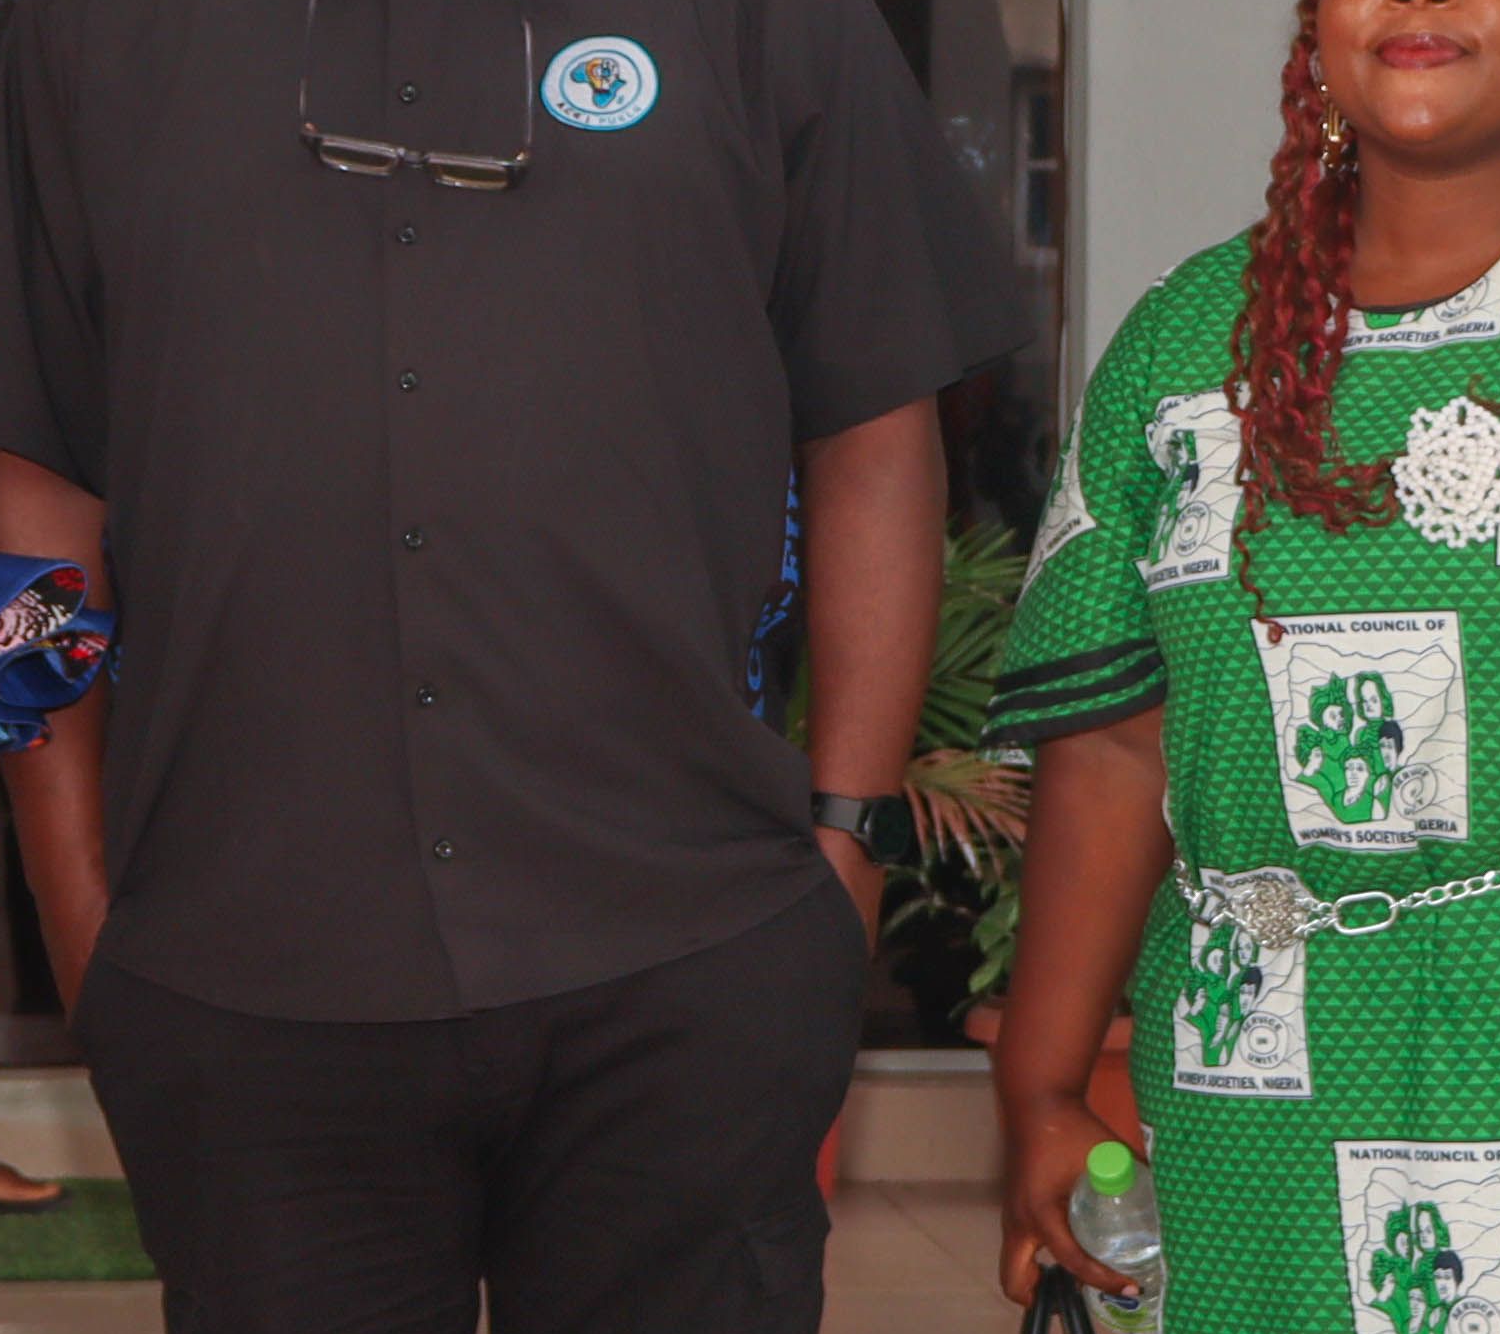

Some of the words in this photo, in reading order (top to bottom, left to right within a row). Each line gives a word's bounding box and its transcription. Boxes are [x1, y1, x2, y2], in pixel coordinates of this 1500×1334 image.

[1183, 559, 1220, 574] NIGERIA
[1282, 622, 1345, 635] ATIONAL
[1351, 620, 1420, 632] COUNCIL
[1425, 619, 1446, 631] OF
[1299, 828, 1352, 843] WOMEN'S
[1262, 1076, 1303, 1090] NIGERIA
[1349, 1148, 1412, 1161] NATIONAL
[1414, 1149, 1479, 1162] COUNCIL
